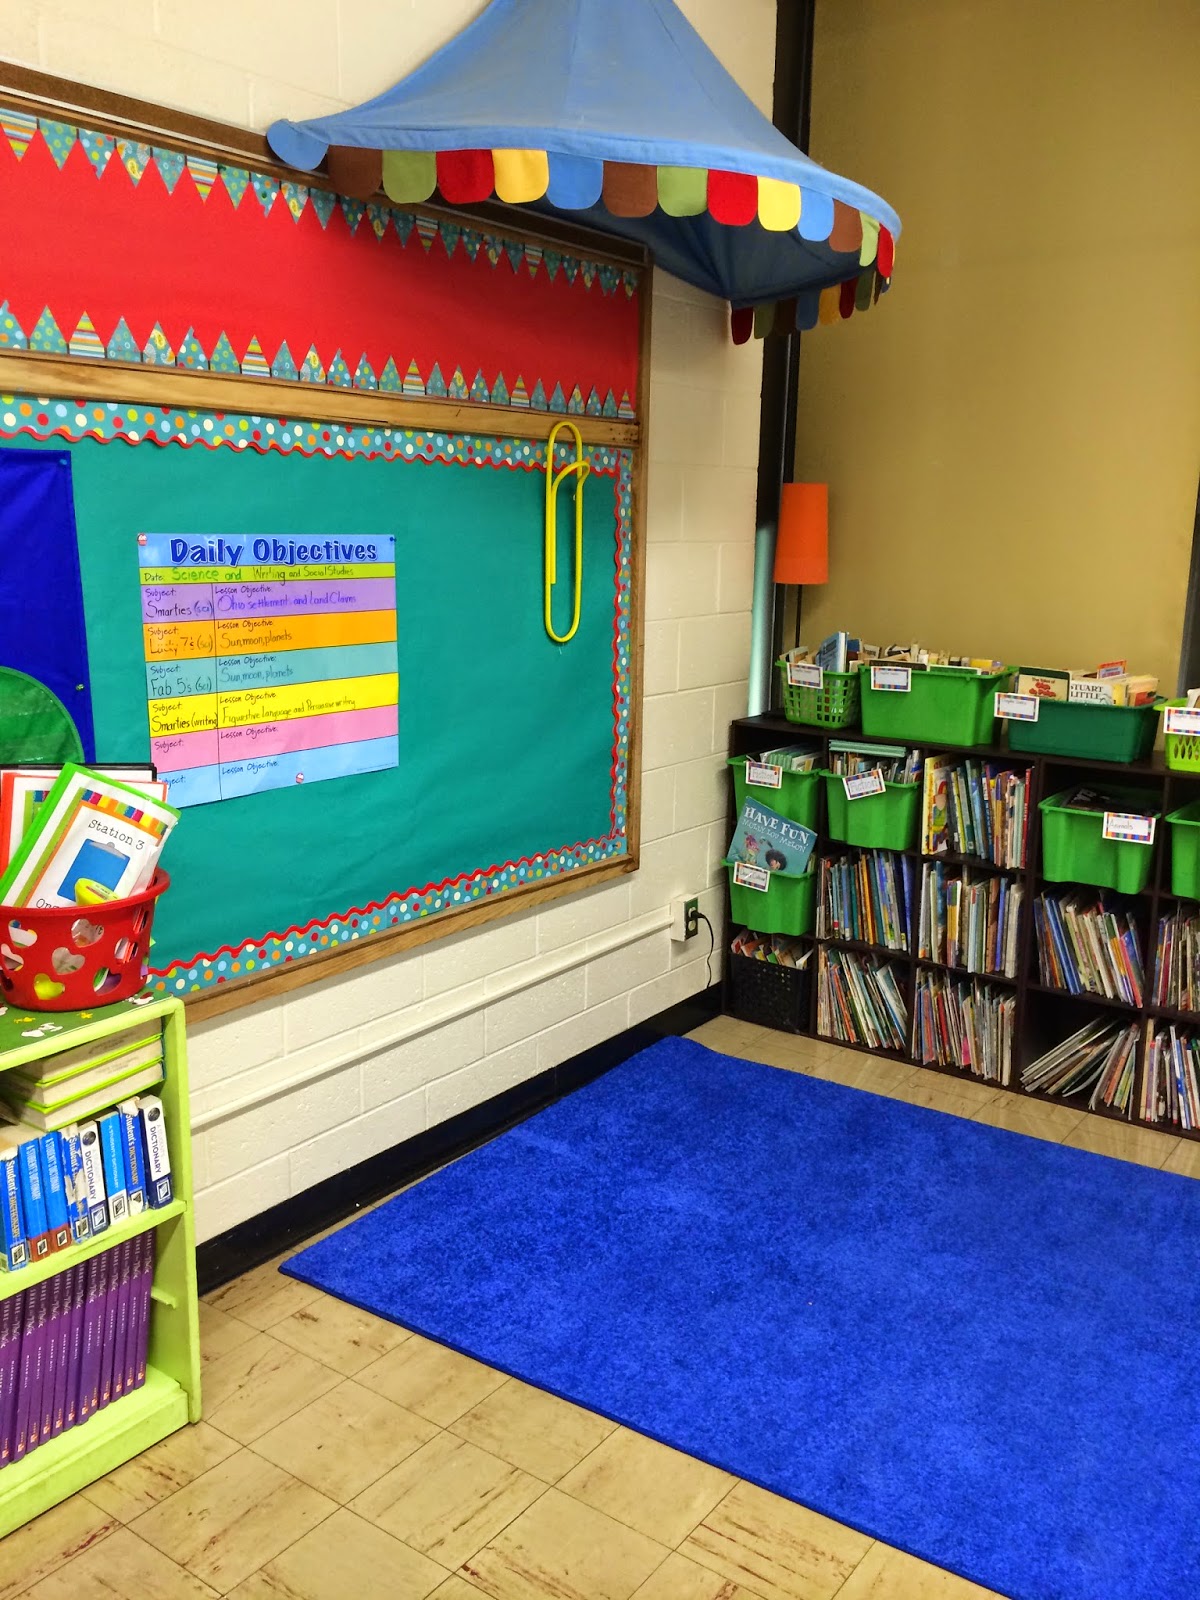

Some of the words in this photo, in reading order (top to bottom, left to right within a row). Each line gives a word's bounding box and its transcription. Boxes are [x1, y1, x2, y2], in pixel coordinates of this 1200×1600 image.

[170, 538, 243, 566] Daily
[253, 538, 377, 566] Objectives
[171, 567, 220, 581] Science
[225, 569, 242, 580] and
[289, 569, 300, 577] and
[215, 586, 237, 594] Lesson
[146, 601, 192, 618] Smarties
[218, 595, 245, 611] Ohio
[293, 594, 307, 605] and
[217, 621, 239, 630] Lesson
[218, 657, 241, 666] Lesson
[151, 678, 172, 697] Fab
[219, 695, 242, 704] Lesson
[152, 715, 190, 732] Smarties
[220, 731, 243, 739] Lesson
[222, 766, 244, 775] Lesson
[88, 819, 134, 846] Station
[135, 839, 145, 850] 3
[743, 806, 779, 829] HAVE
[780, 822, 810, 847] FUN,
[36, 898, 60, 908] On
[150, 1126, 162, 1173] DICTIONARY
[6, 1160, 18, 1196] Student's
[85, 1150, 97, 1200] DICTIONARY
